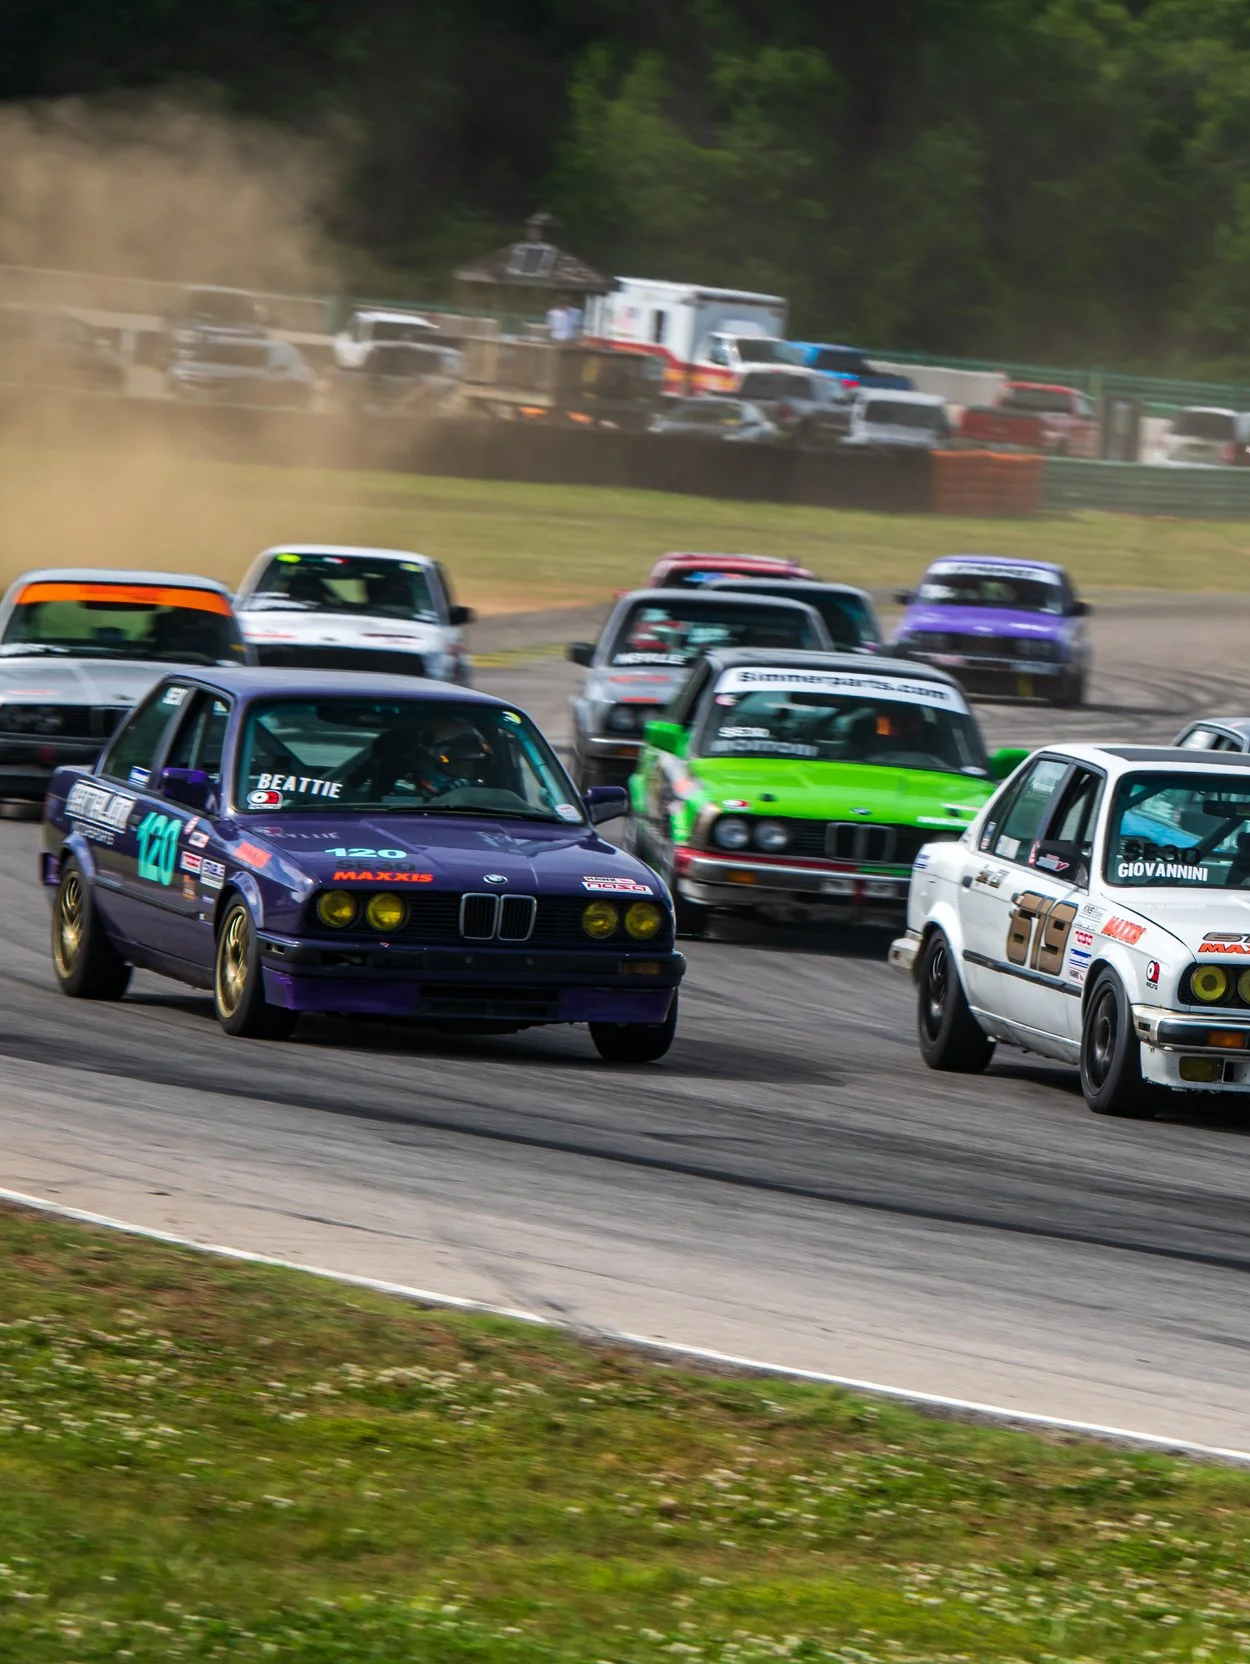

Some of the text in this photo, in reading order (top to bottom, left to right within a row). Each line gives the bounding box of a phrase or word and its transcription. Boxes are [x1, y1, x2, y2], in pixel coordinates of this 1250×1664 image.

[737, 671, 950, 700] Bimmerparts.com
[257, 773, 343, 799] BEATTIE
[136, 812, 183, 886] 120
[324, 847, 408, 859] 120
[332, 871, 435, 883] MAXXIS
[1117, 862, 1209, 882] GIOVANNINI
[1101, 915, 1147, 946] MAXXIS
